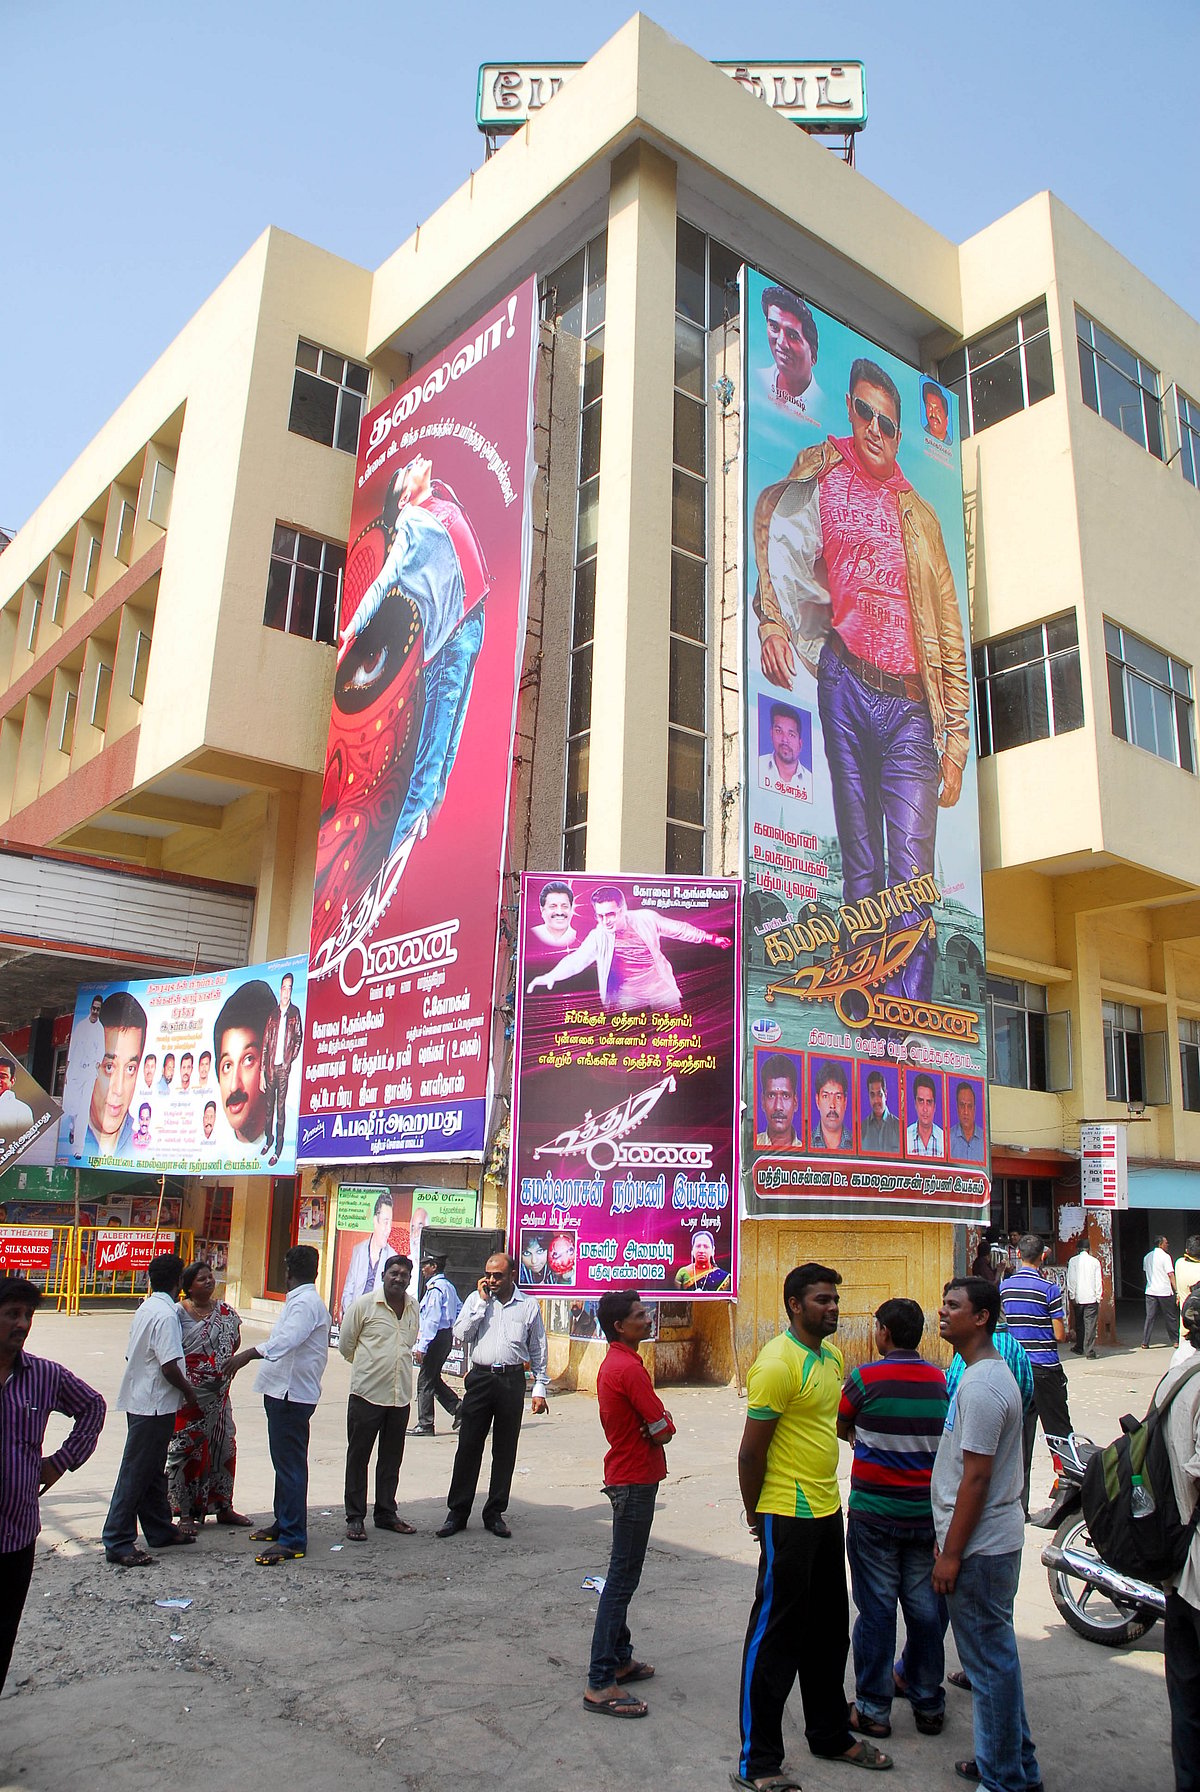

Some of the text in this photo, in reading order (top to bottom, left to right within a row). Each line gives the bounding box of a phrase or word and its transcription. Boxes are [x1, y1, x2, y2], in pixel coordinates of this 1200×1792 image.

[366, 295, 518, 460] தலைவா!
[754, 822, 818, 851] கலைஞானி
[754, 845, 828, 878] உலகநாயகன்
[633, 885, 671, 898] கோவை
[763, 865, 941, 966] கமல் ஹாசன்
[754, 1019, 776, 1033] JP
[554, 1031, 594, 1047] புன்னகை
[538, 1051, 572, 1069] என்றும்
[577, 1052, 619, 1067] எங்களின்
[757, 1165, 790, 1188] மத்திய
[791, 1167, 832, 1186] சென்னை
[833, 1171, 849, 1186] Dr.
[923, 1175, 953, 1195] நற்பணி
[954, 1177, 985, 1195] இயக்கம்
[520, 1170, 729, 1216] கமல்ஹாசன் நற்பணி இயக்கம்
[11, 1229, 49, 1237] THEATRE
[102, 1232, 134, 1240] ALBERT
[5, 1245, 50, 1255] SILK SAREES
[580, 1238, 674, 1264] மகளிர் அமைப்பு
